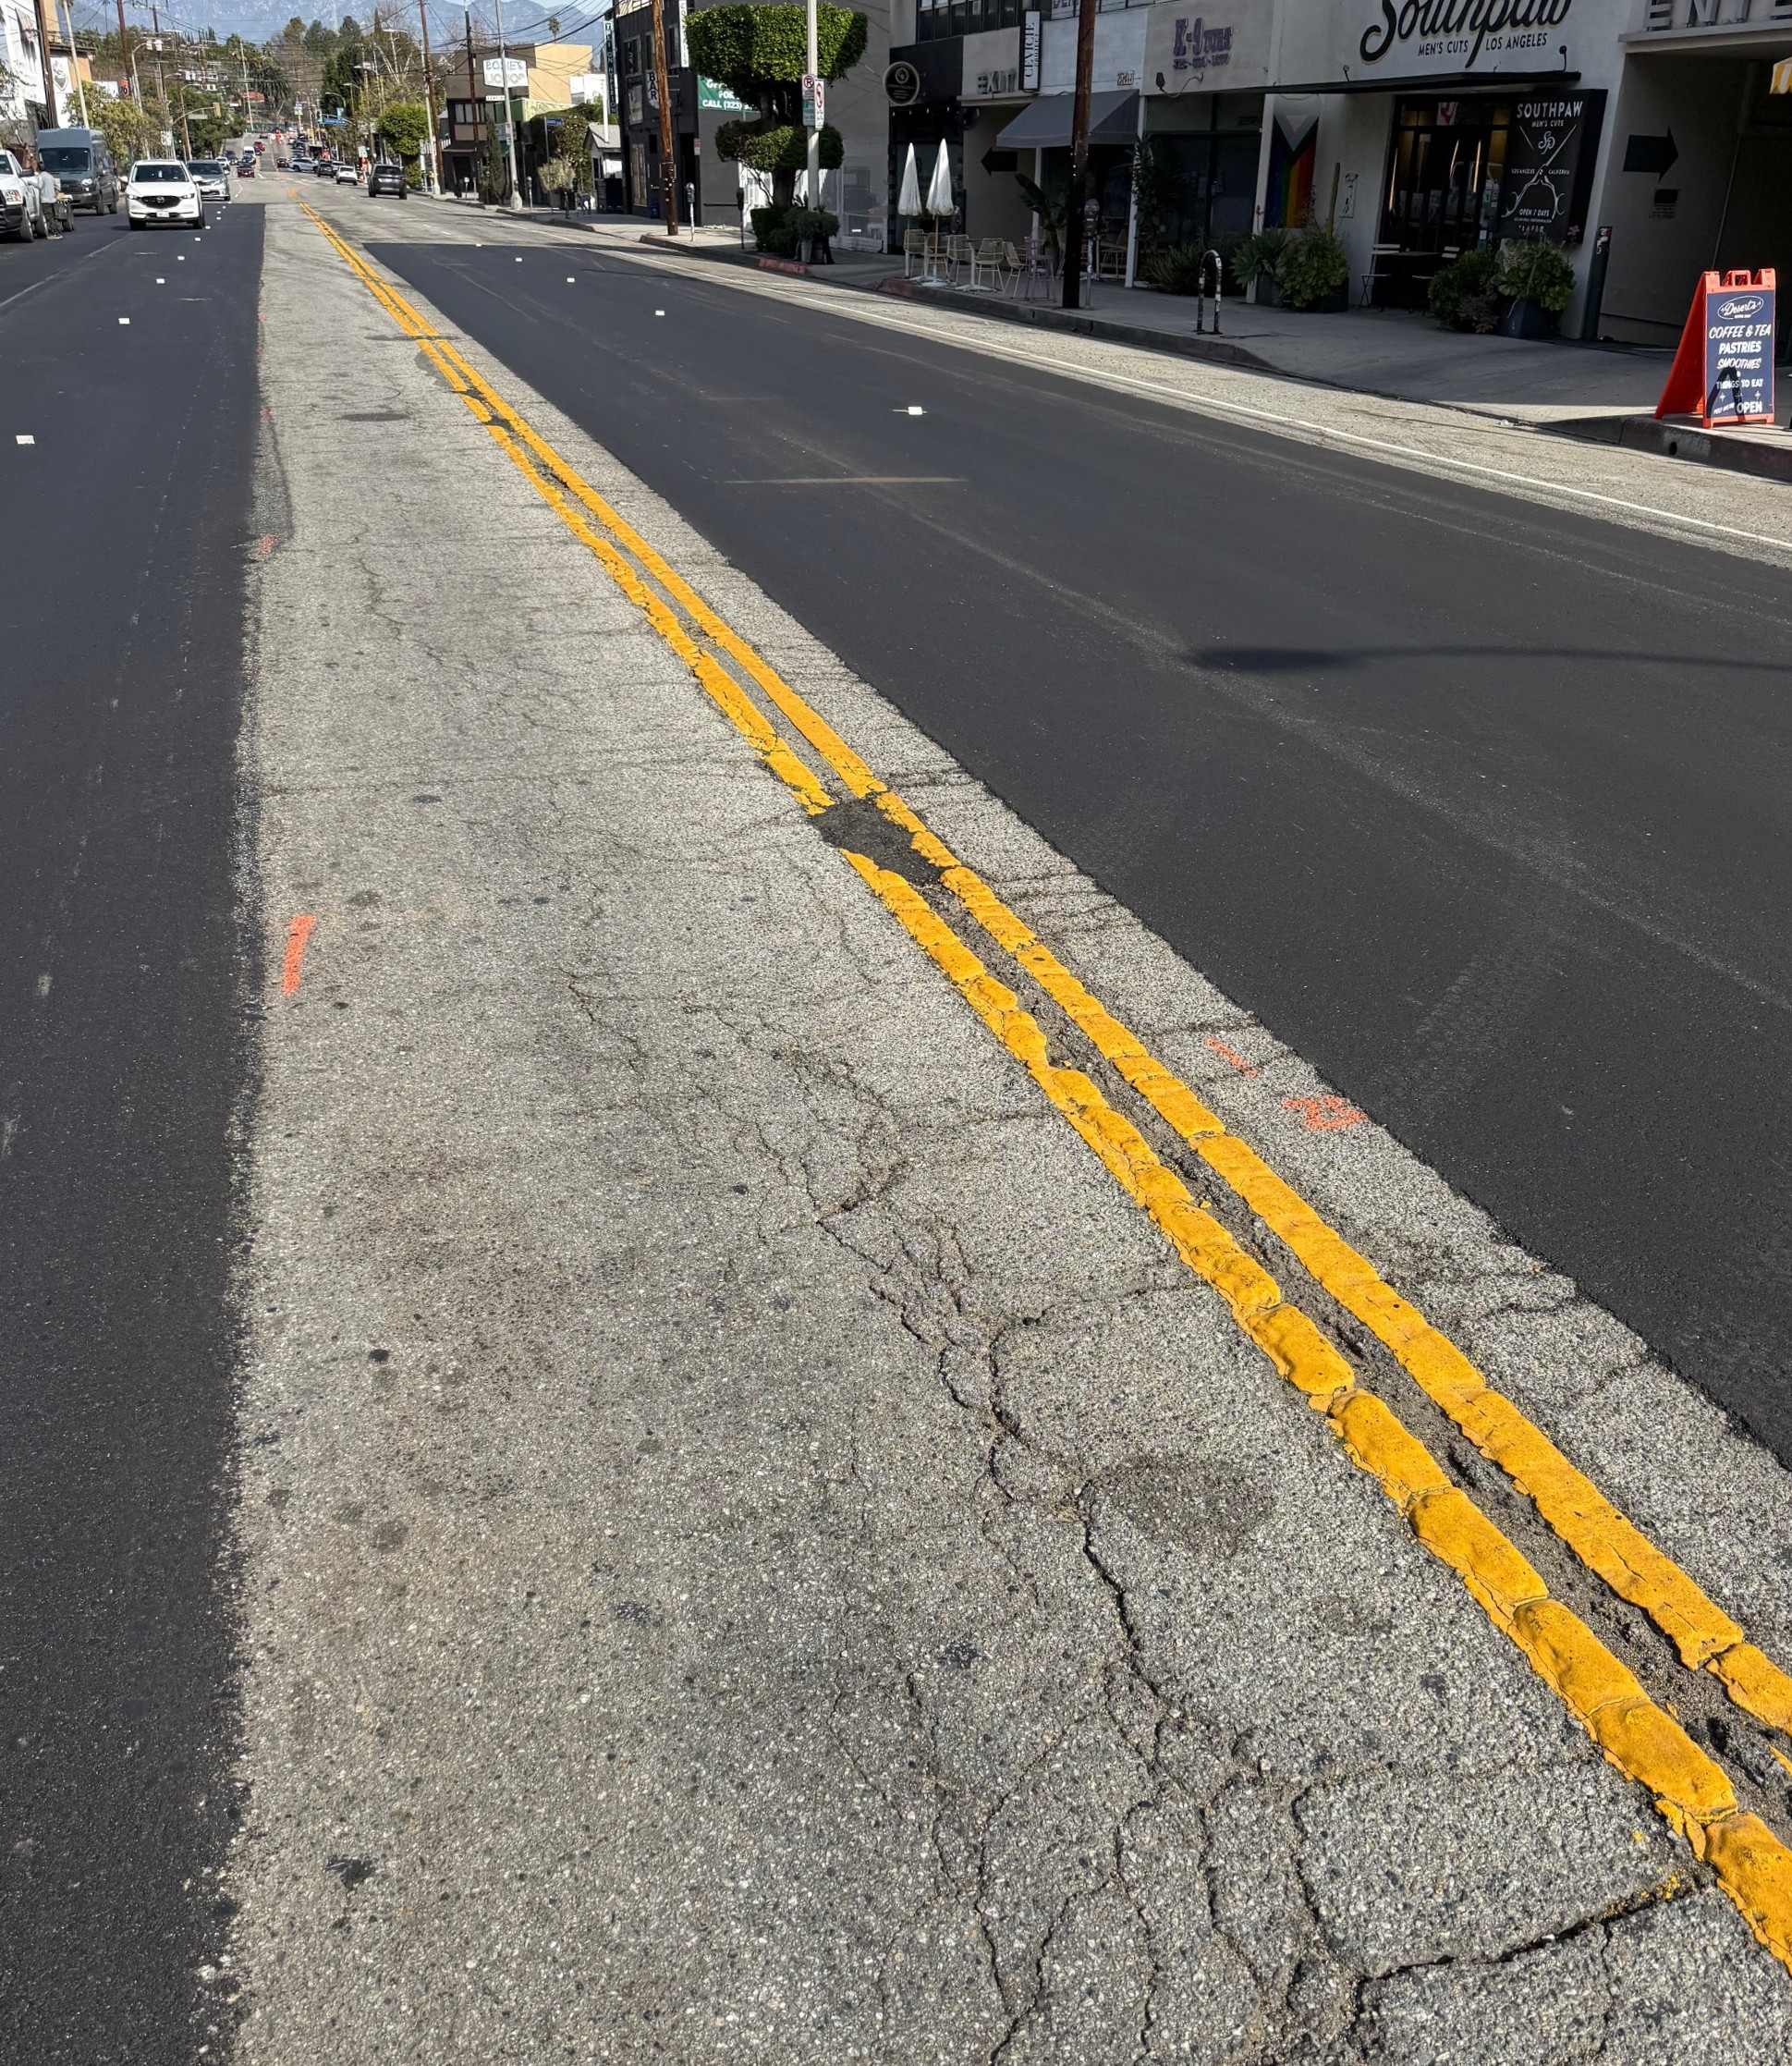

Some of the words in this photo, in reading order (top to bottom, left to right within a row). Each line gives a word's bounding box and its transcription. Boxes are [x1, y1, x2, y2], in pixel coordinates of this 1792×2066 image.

[1418, 43, 1444, 56] MEN'S
[1446, 40, 1469, 55] CUTS
[1485, 37, 1504, 51] LOS
[1506, 32, 1548, 50] ANGELES
[649, 72, 657, 101] BAR
[702, 99, 723, 108] CALL
[723, 100, 743, 110] (323)
[1517, 101, 1584, 118] SOUTHPAW
[1531, 119, 1548, 128] MEN'S
[1550, 119, 1565, 128] CUTS
[1519, 208, 1532, 216] OPEN
[1537, 209, 1550, 217] DAYS
[1709, 324, 1744, 339] COFFEE
[1745, 324, 1753, 336] &
[1755, 324, 1772, 336] TEA
[1718, 341, 1762, 355] PASTRIES
[1716, 358, 1762, 370] SMOOTHIES
[1740, 379, 1750, 388] TO
[1751, 378, 1764, 387] EAT
[1737, 401, 1762, 414] OPEN
